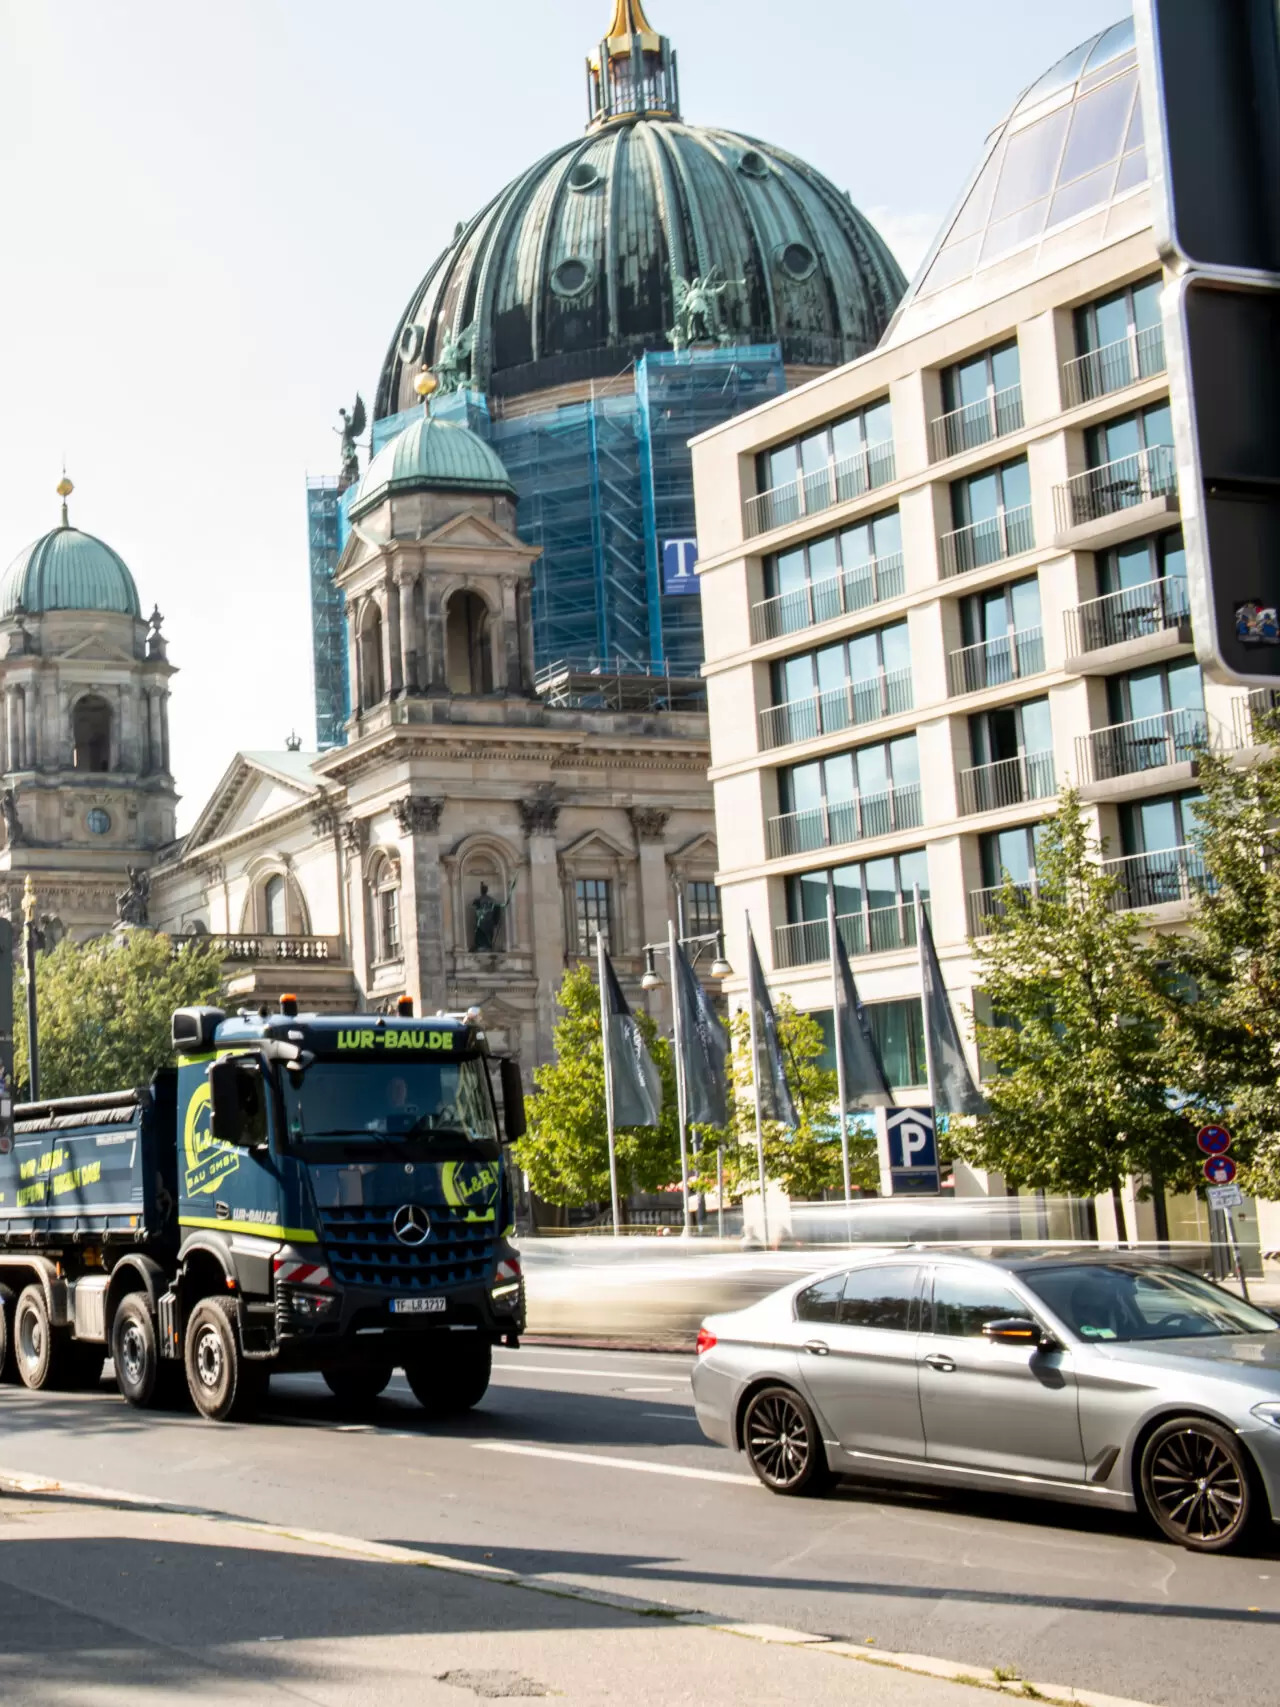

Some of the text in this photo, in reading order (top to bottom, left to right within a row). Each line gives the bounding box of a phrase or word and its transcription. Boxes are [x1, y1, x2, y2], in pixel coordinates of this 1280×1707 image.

[337, 1030, 453, 1050] LUR-BAU.DE
[900, 1123, 926, 1167] P
[459, 1169, 495, 1198] L&R
